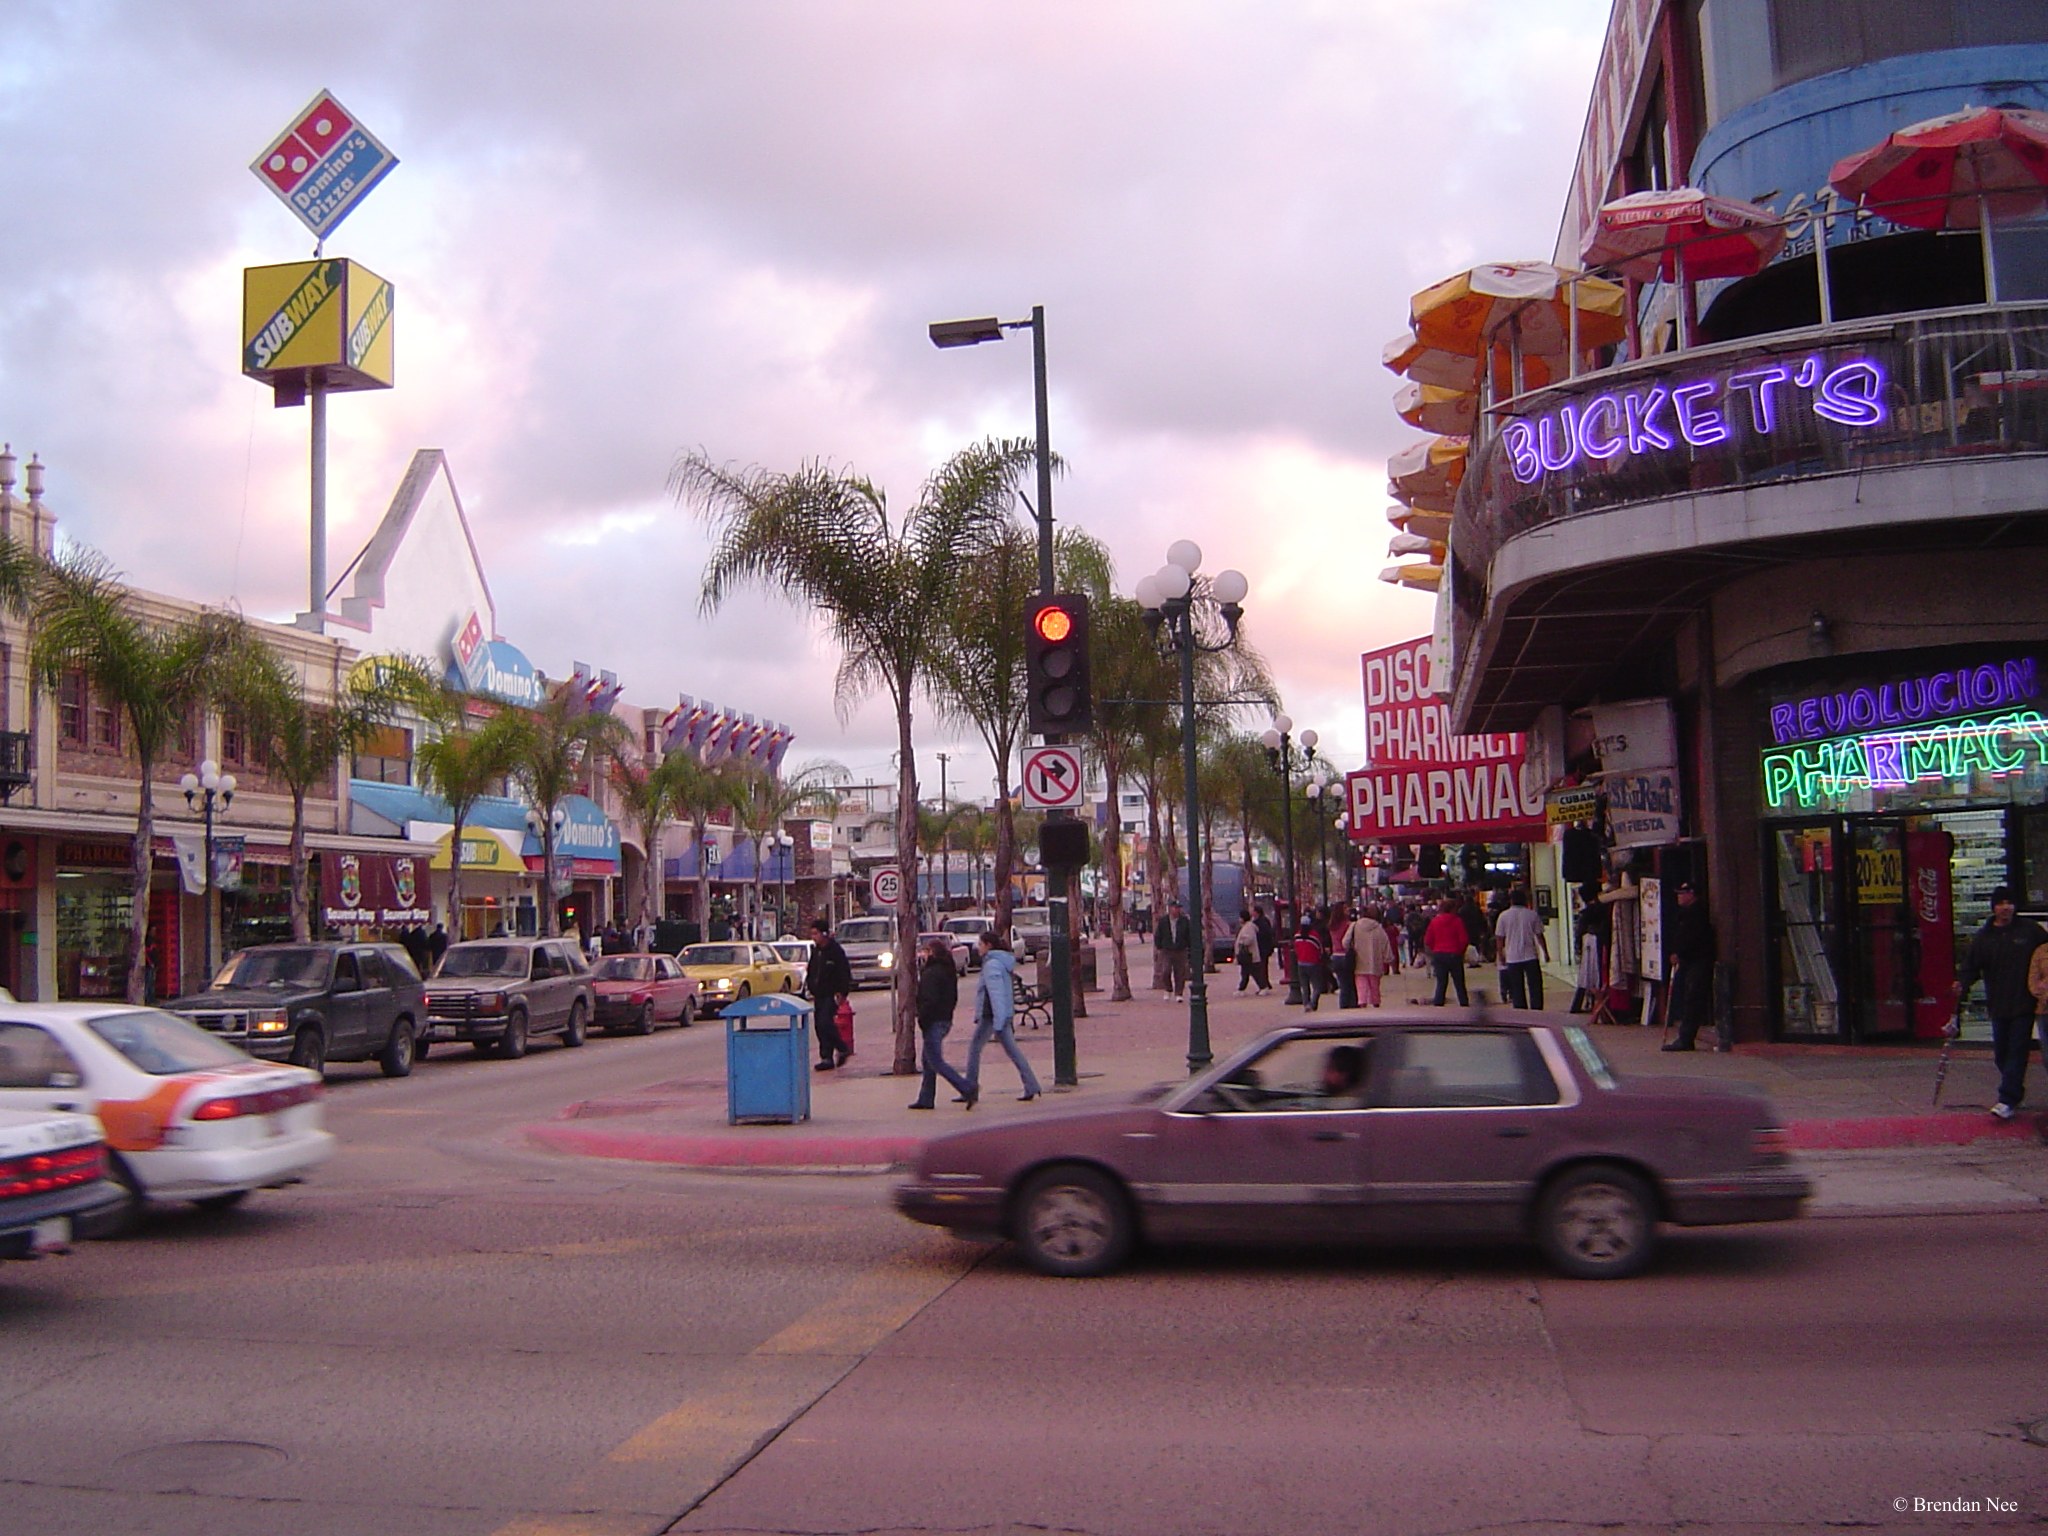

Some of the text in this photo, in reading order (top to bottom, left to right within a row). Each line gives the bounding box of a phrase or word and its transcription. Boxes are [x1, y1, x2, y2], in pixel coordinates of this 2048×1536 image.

[294, 135, 367, 210] Domino's
[308, 176, 355, 227] Pizza
[254, 262, 332, 369] SUBWAY
[352, 285, 391, 366] SUBWAY
[1501, 354, 1884, 485] BUCKET'S
[486, 659, 541, 703] Domino's
[1769, 658, 2037, 743] REVOLUCION
[1763, 711, 2048, 807] PHARMACY
[1559, 792, 1594, 805] CUBAN
[1627, 818, 1666, 832] FIESTA
[563, 813, 613, 848] Domino's
[881, 877, 897, 891] 25
